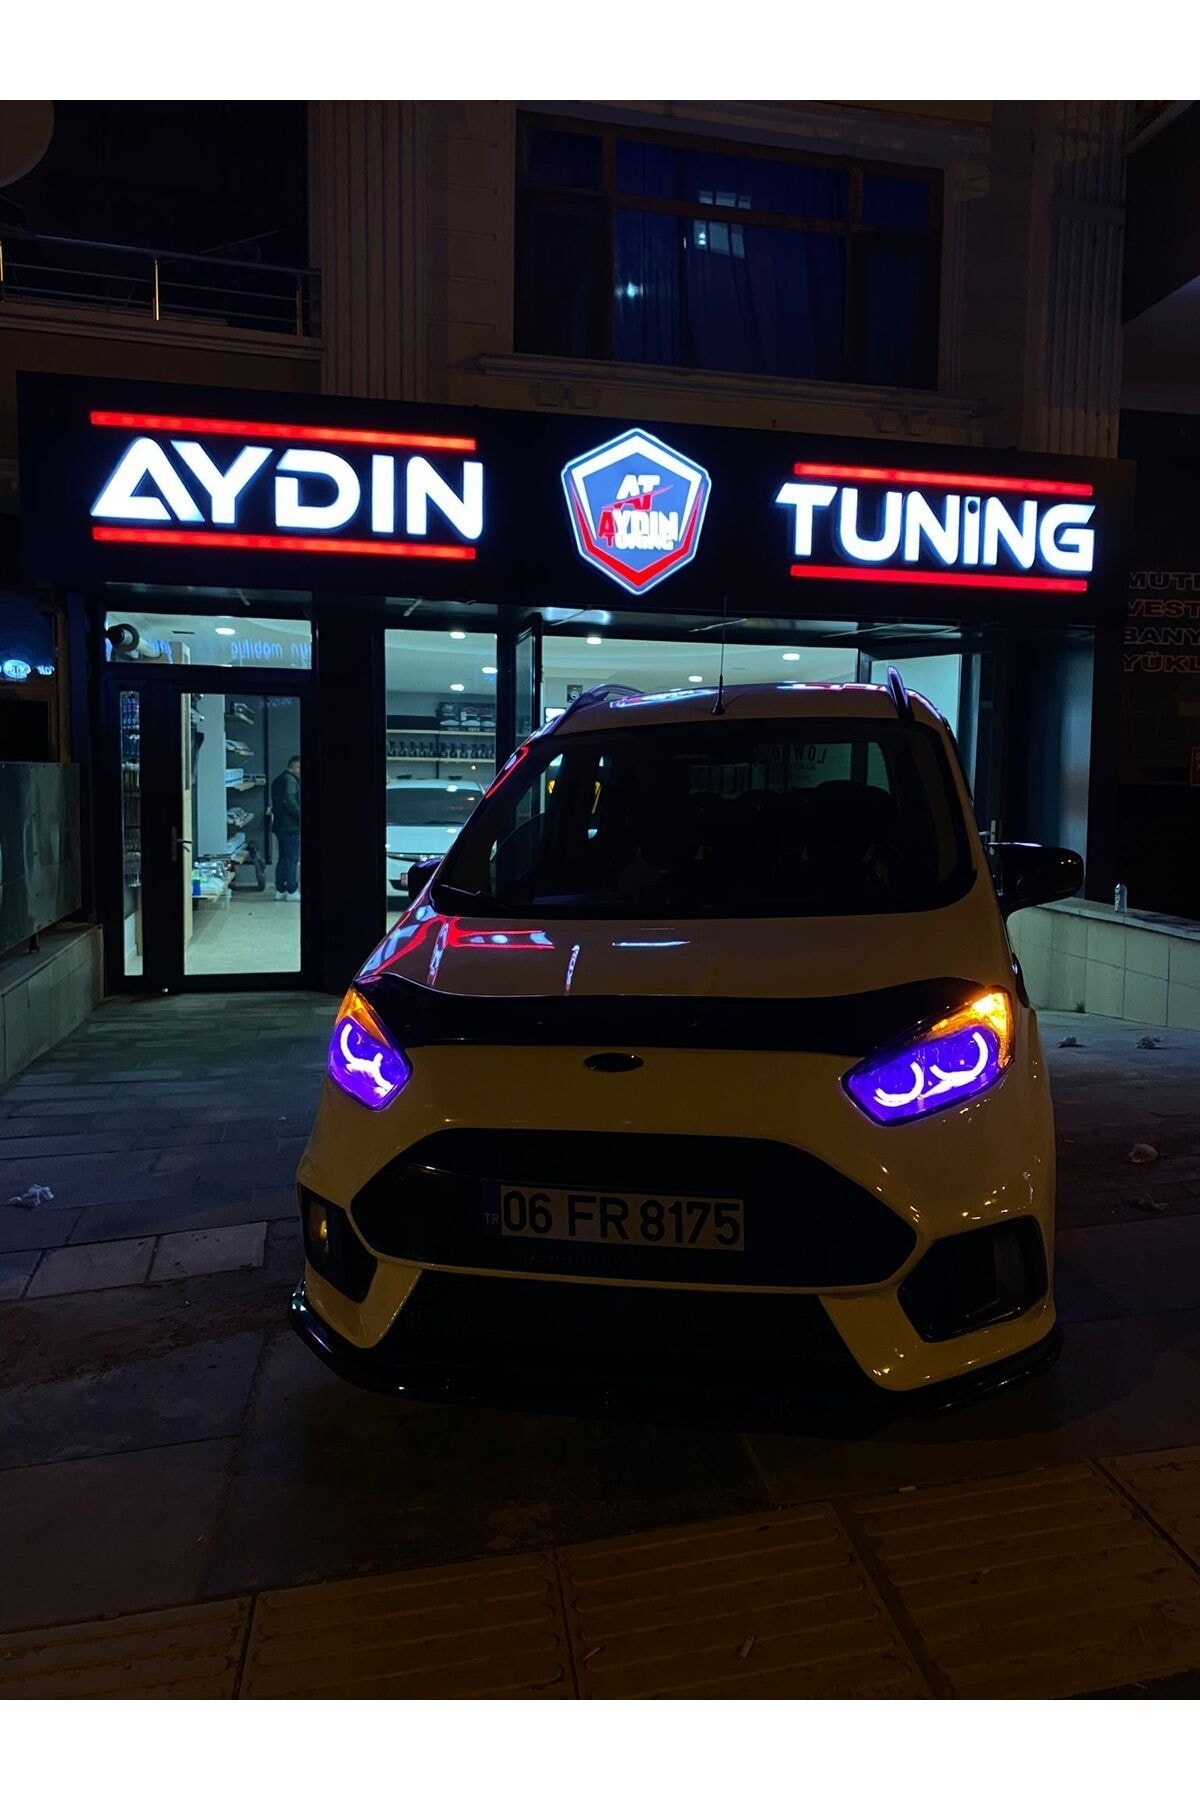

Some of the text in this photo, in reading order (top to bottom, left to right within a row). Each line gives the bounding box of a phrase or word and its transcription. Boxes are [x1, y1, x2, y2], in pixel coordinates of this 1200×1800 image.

[90, 436, 484, 541] AYDIN
[611, 474, 661, 511] AT
[598, 509, 679, 539] AYDIN
[503, 1191, 552, 1233] 06
[567, 1195, 629, 1239] FR
[640, 1200, 740, 1245] 8175
